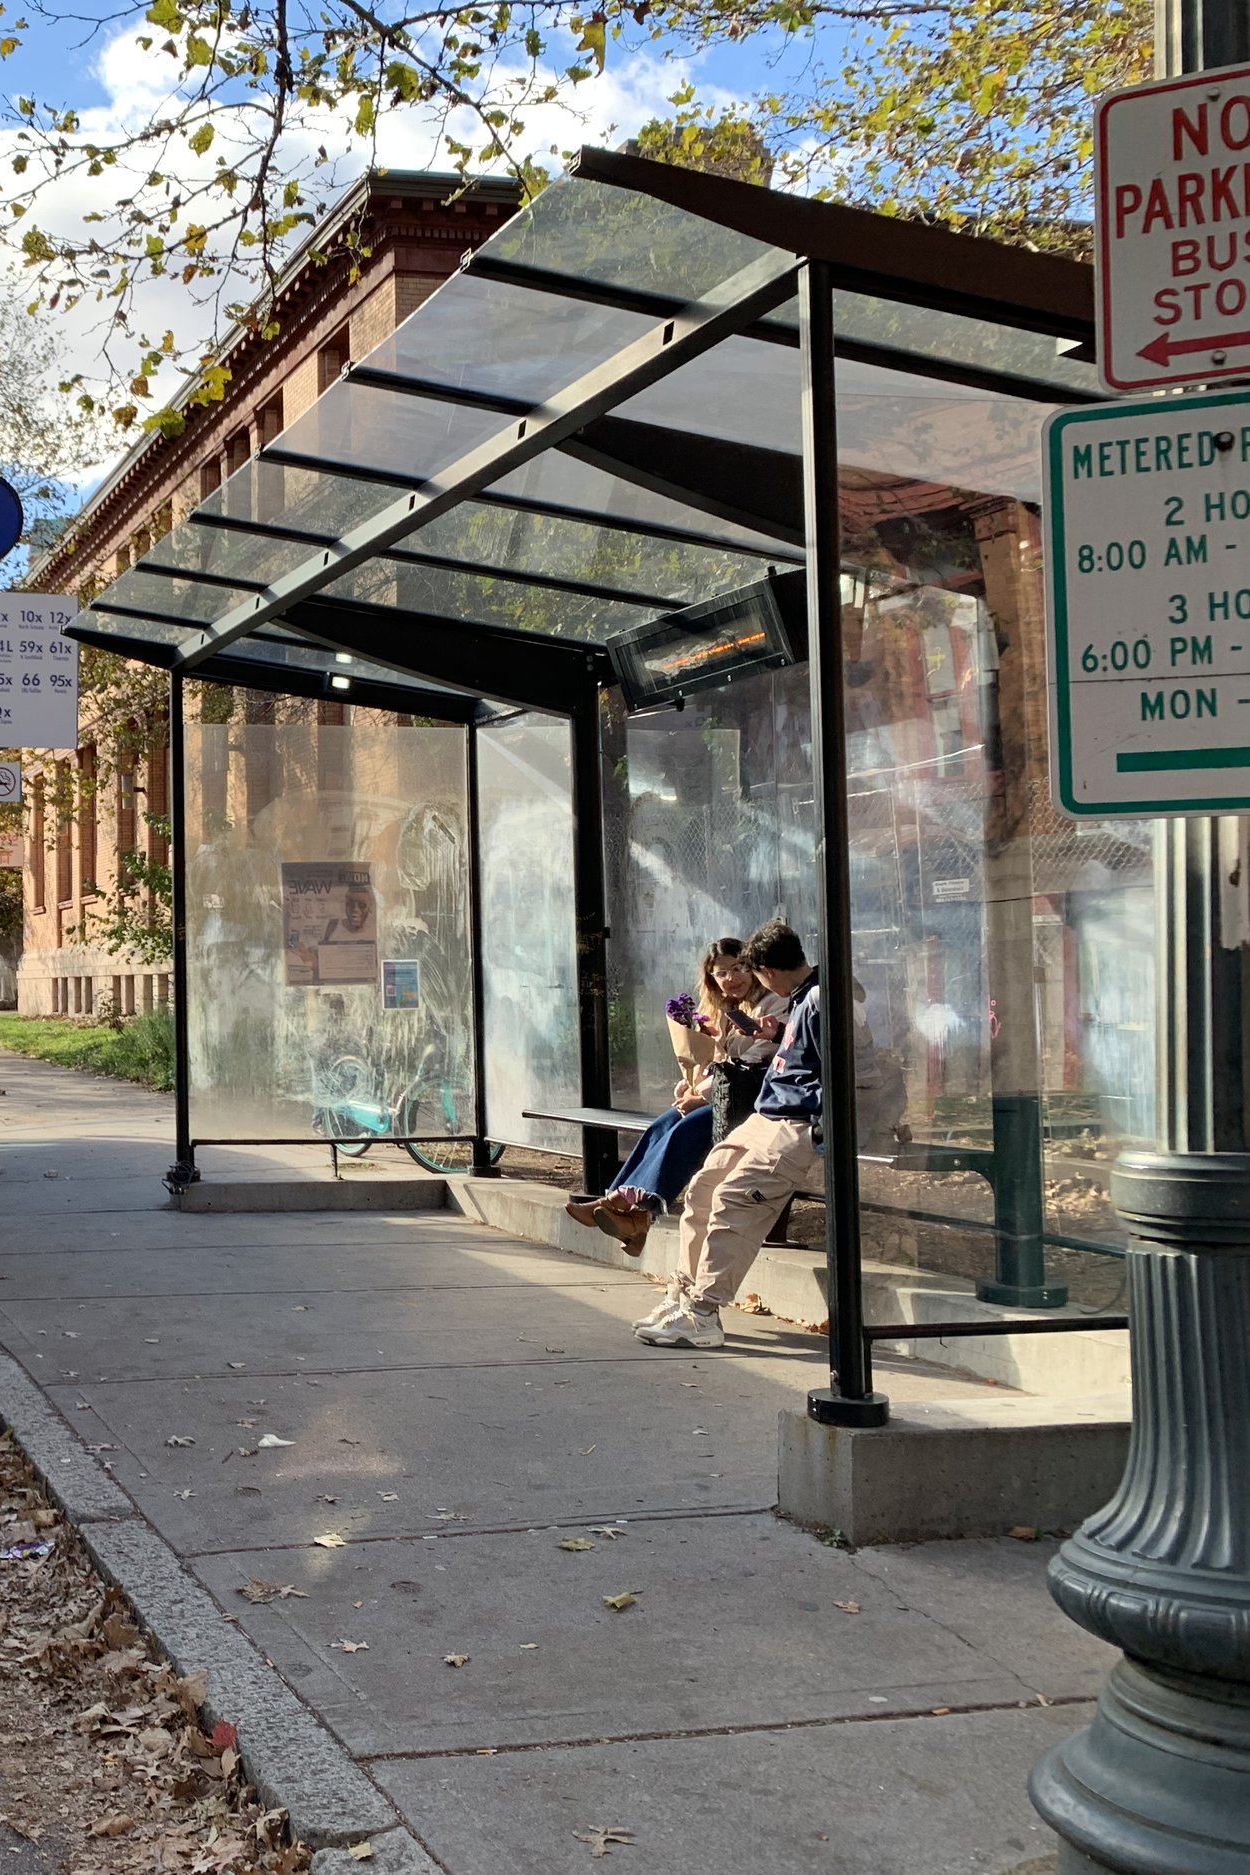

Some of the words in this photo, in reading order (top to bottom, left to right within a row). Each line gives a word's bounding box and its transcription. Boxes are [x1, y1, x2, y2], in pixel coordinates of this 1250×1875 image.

[1172, 95, 1250, 161] NO
[1153, 278, 1247, 326] STO
[1073, 431, 1216, 479] METERED
[1164, 496, 1185, 526] 2
[1205, 489, 1250, 522] HO
[1078, 540, 1147, 574] 8:00
[1164, 534, 1209, 567] AM
[20, 610, 42, 623] 10x
[49, 611, 71, 625] 12x
[1168, 594, 1189, 624] 3
[19, 641, 43, 653] 59x
[49, 642, 72, 654] 61x
[1082, 639, 1151, 673] 6:00
[1170, 635, 1214, 667] PM
[22, 673, 41, 686] 66
[50, 675, 72, 687] 95x
[1141, 688, 1218, 721] MON
